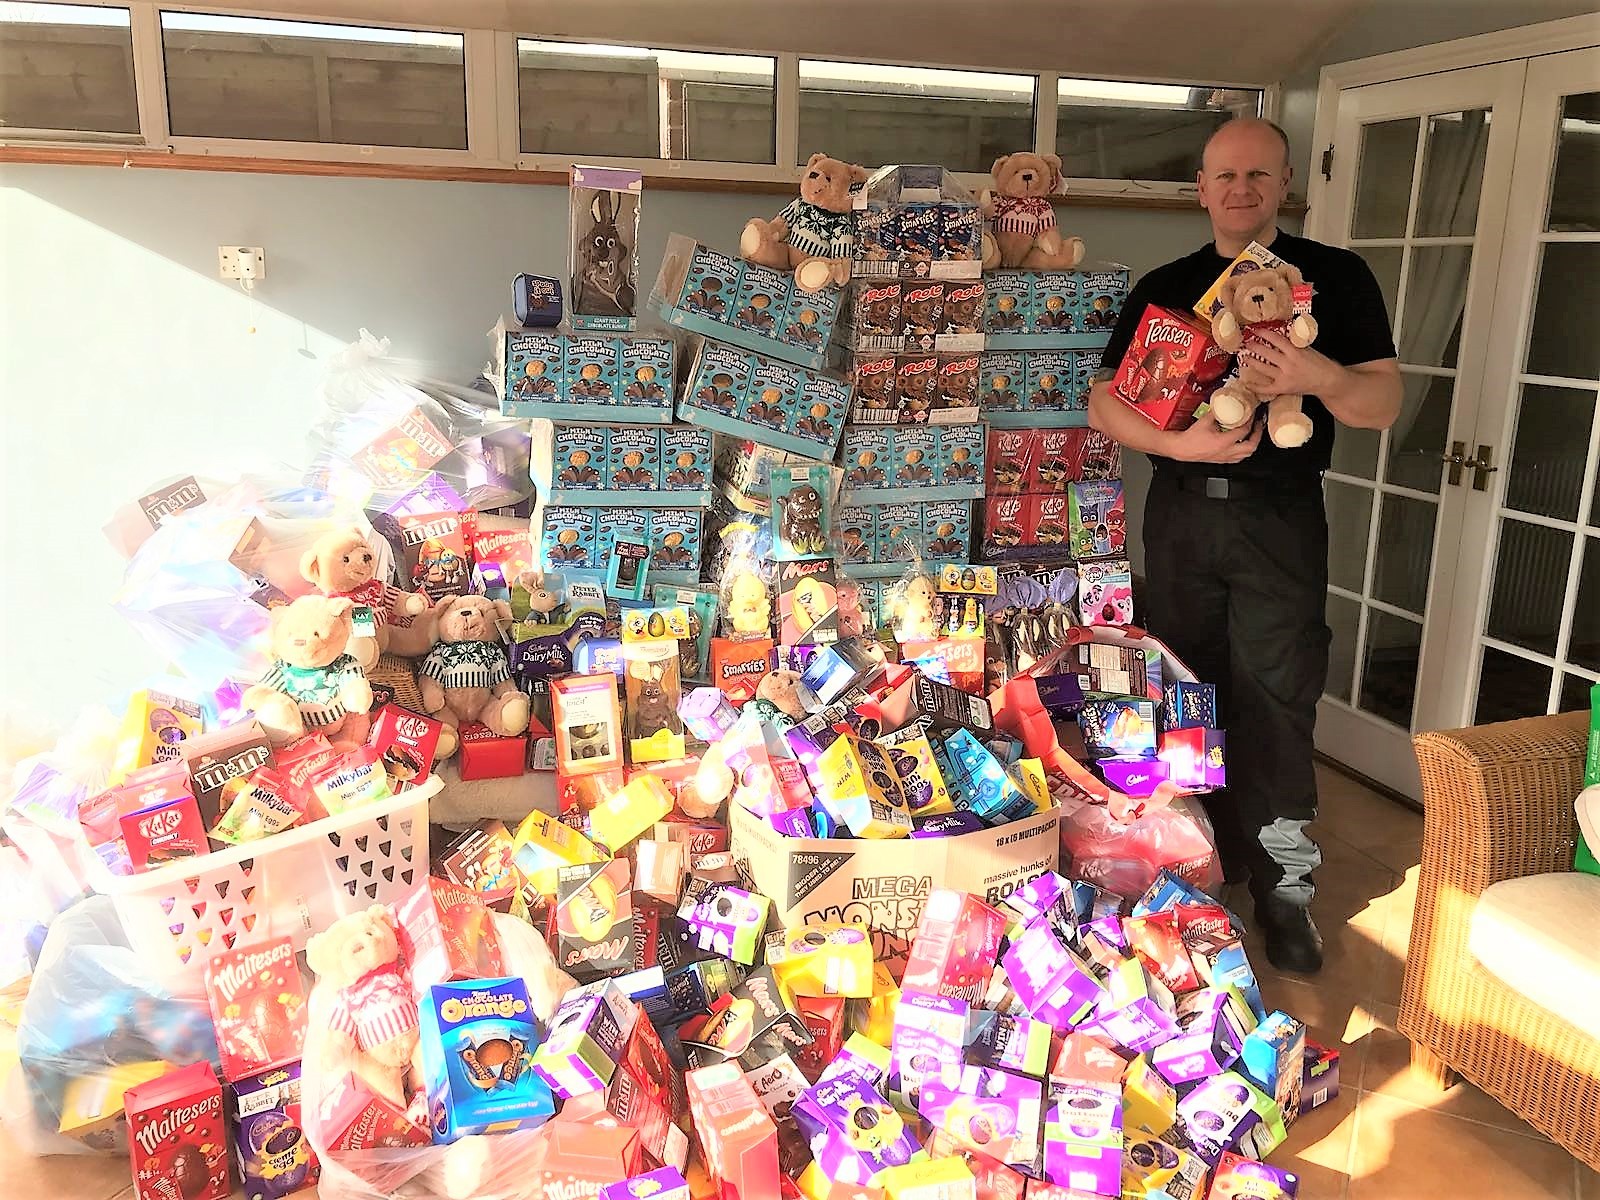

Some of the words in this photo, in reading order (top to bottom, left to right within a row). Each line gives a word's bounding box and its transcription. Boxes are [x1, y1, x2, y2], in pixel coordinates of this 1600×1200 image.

[709, 252, 729, 265] MILK
[695, 255, 739, 277] CHOCOLATE
[757, 269, 778, 282] MILK
[998, 275, 1018, 284] MILK
[1046, 274, 1066, 283] MILK
[1092, 274, 1113, 282] MILK
[745, 273, 787, 293] CHOCOLATE
[987, 280, 1030, 291] CHOCOLATE
[1034, 280, 1078, 291] CHOCOLATE
[1082, 279, 1125, 291] CHOCOLATE
[1145, 318, 1194, 348] Teasers
[524, 336, 548, 345] MILK
[581, 340, 602, 348] MILK
[512, 342, 560, 353] CHOCOLATE
[569, 346, 616, 357] CHOCOLATE
[635, 343, 656, 351] MILK
[624, 349, 669, 360] CHOCOLATE
[719, 349, 740, 361] MILK
[706, 353, 749, 373] CHOCOLATE
[982, 359, 1022, 369] CHOCOLATE
[1029, 359, 1070, 368] CHOCOLATE
[1077, 359, 1101, 368] CHOCO
[769, 365, 789, 377] MILK
[756, 369, 799, 387] CHOCOLATE
[816, 380, 837, 391] MILK
[804, 383, 846, 401] CHOCOLATE
[557, 433, 604, 444] CHOCOLATE
[623, 429, 644, 437] MILK
[676, 430, 697, 438] MILK
[858, 430, 876, 438] MILK
[894, 434, 935, 443] CHOCOLATE
[941, 432, 981, 441] CHOCOLATE
[611, 435, 656, 445] CHOCOLATE
[665, 436, 709, 447] CHOCOLATE
[847, 436, 888, 445] CHOCOLATE
[558, 507, 580, 515] MILK
[664, 510, 685, 518] MILK
[879, 511, 919, 520] CHOCOLATE
[927, 509, 967, 518] CHOCOLATE
[546, 513, 592, 524] CHOCOLATE
[600, 515, 645, 525] CHOCOLATE
[652, 517, 697, 527] CHOCOLATE
[474, 532, 528, 558] Maltesers
[522, 650, 546, 664] Dairy
[395, 715, 429, 738] KitKat
[156, 746, 181, 756] Mini
[327, 764, 373, 791] Milkybar
[251, 787, 295, 816] Milkybar
[139, 809, 182, 838] KitKat
[792, 854, 819, 865] 78496
[794, 867, 819, 890] BIGGER
[818, 859, 831, 871] LIKE
[984, 868, 1019, 884] massive
[1020, 861, 1044, 874] hunks
[852, 876, 932, 899] MEGA
[434, 887, 485, 914] Maltesers
[214, 943, 292, 1001] Maltesers
[462, 993, 515, 1005] CHOCOLATE
[441, 997, 527, 1023] Orange
[760, 1067, 783, 1091] Aero
[136, 1094, 221, 1155] Maltesers
[268, 1147, 298, 1166] creme
[273, 1157, 295, 1170] egg
